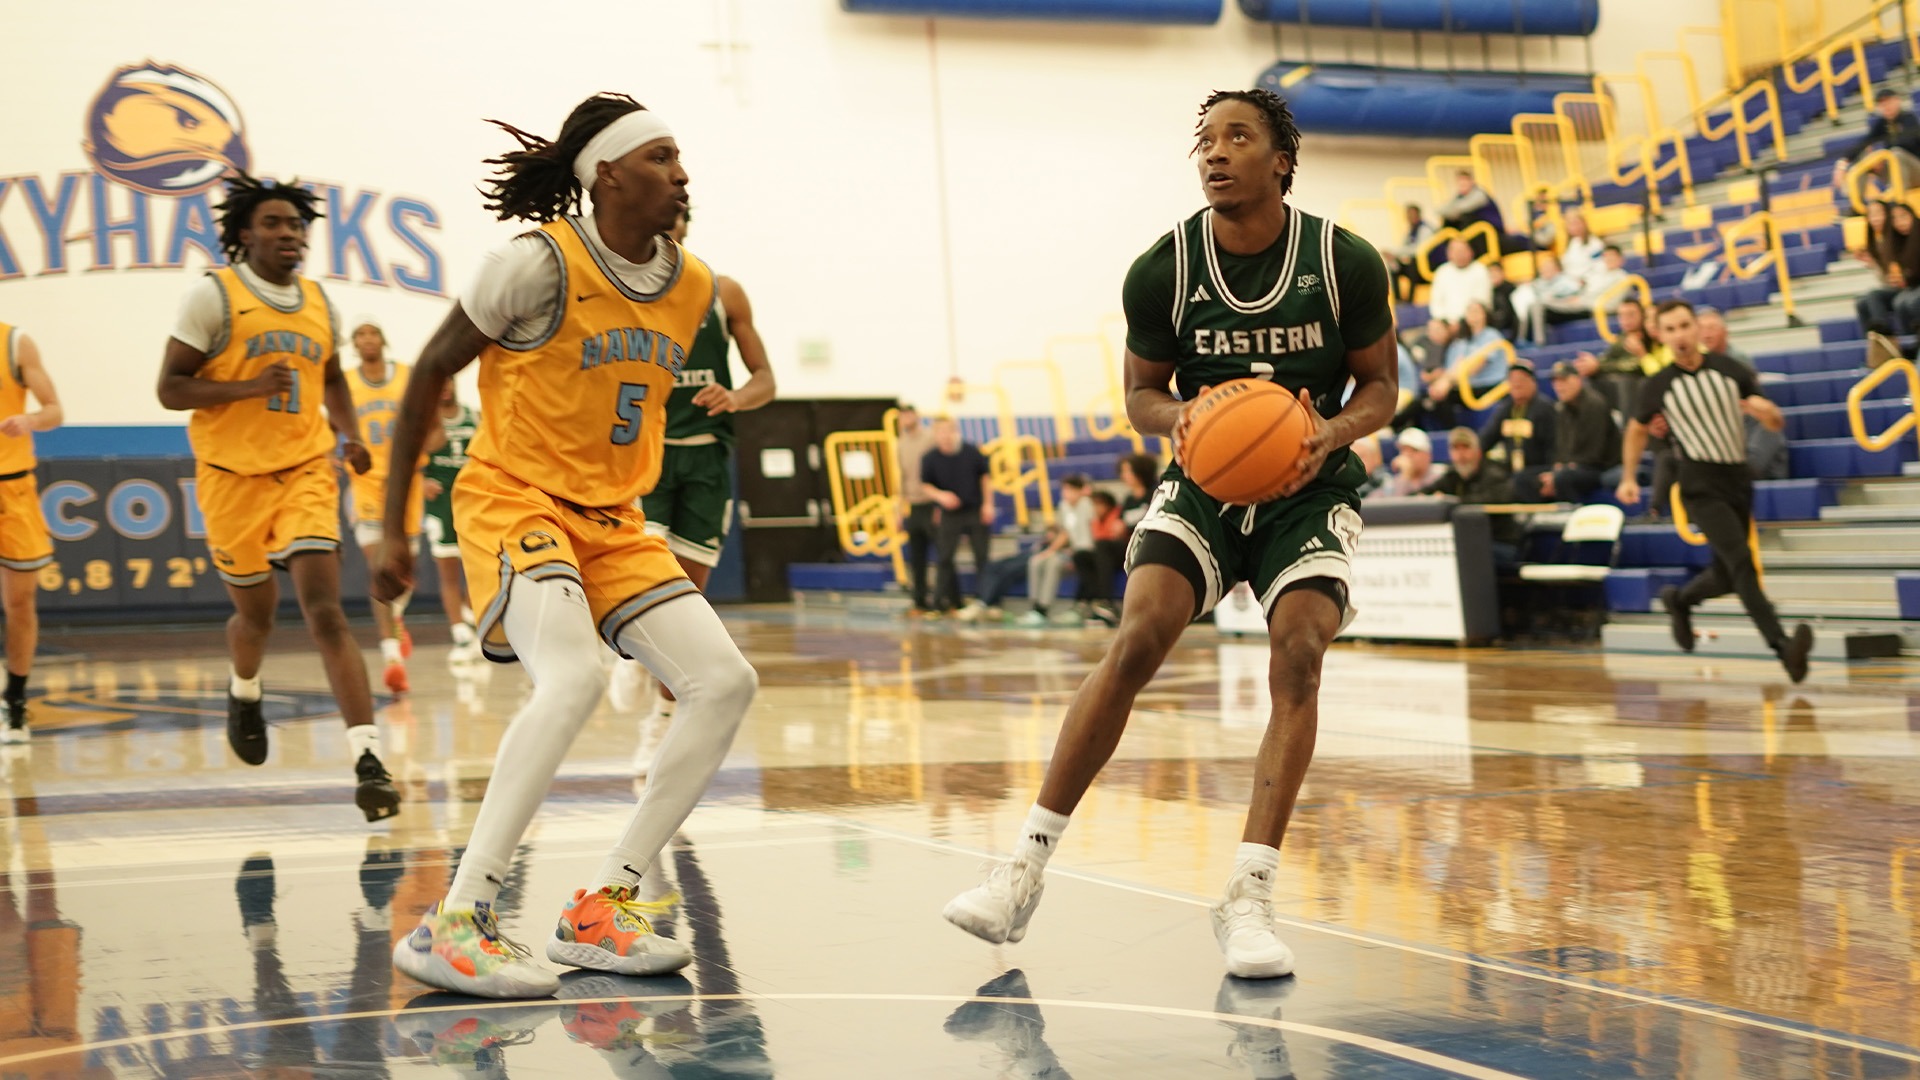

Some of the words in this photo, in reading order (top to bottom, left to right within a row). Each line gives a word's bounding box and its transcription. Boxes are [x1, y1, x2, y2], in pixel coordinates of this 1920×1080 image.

[580, 327, 687, 378] HAWKS
[1195, 321, 1324, 355] EASTERN
[610, 382, 649, 445] 5
